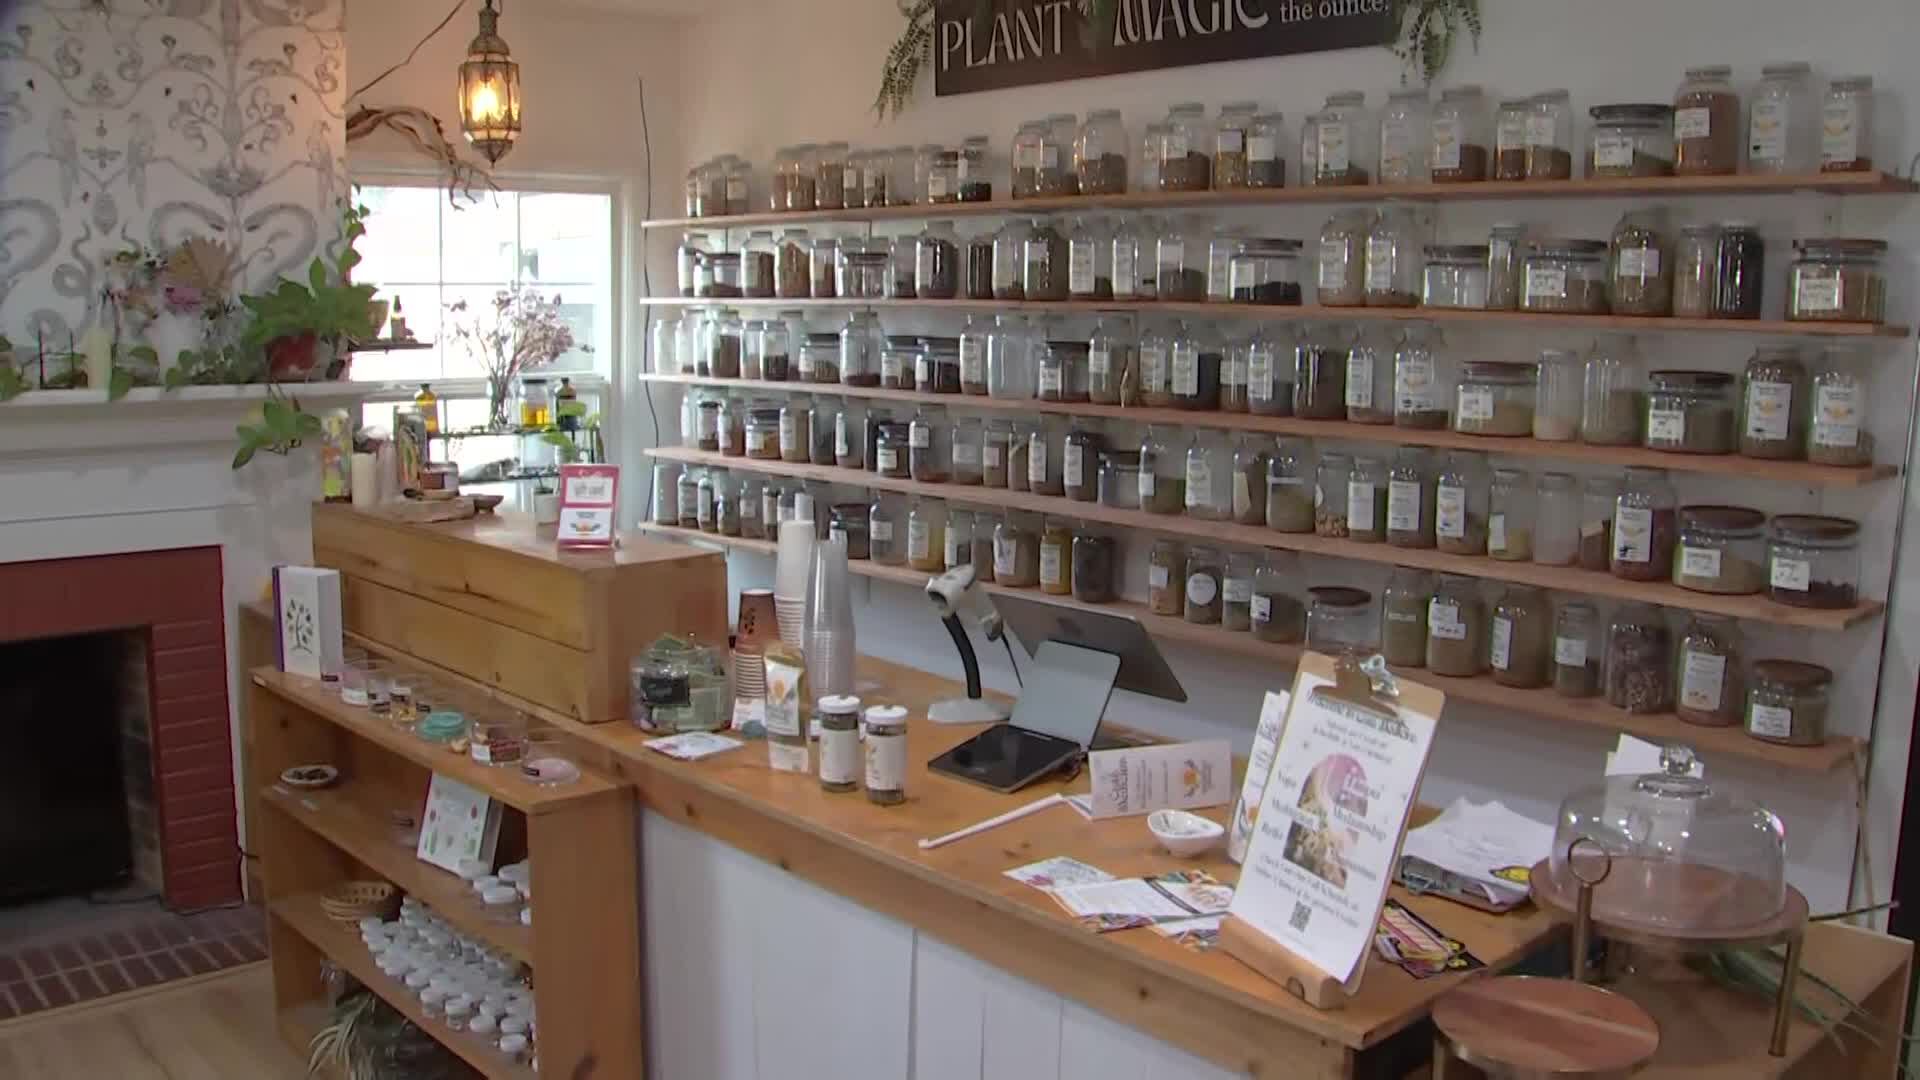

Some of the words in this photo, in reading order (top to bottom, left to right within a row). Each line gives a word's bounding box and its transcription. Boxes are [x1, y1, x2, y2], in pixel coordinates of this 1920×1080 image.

[1280, 0, 1313, 23] the
[941, 2, 1071, 72] PLANT
[1113, 0, 1269, 46] MAGIC
